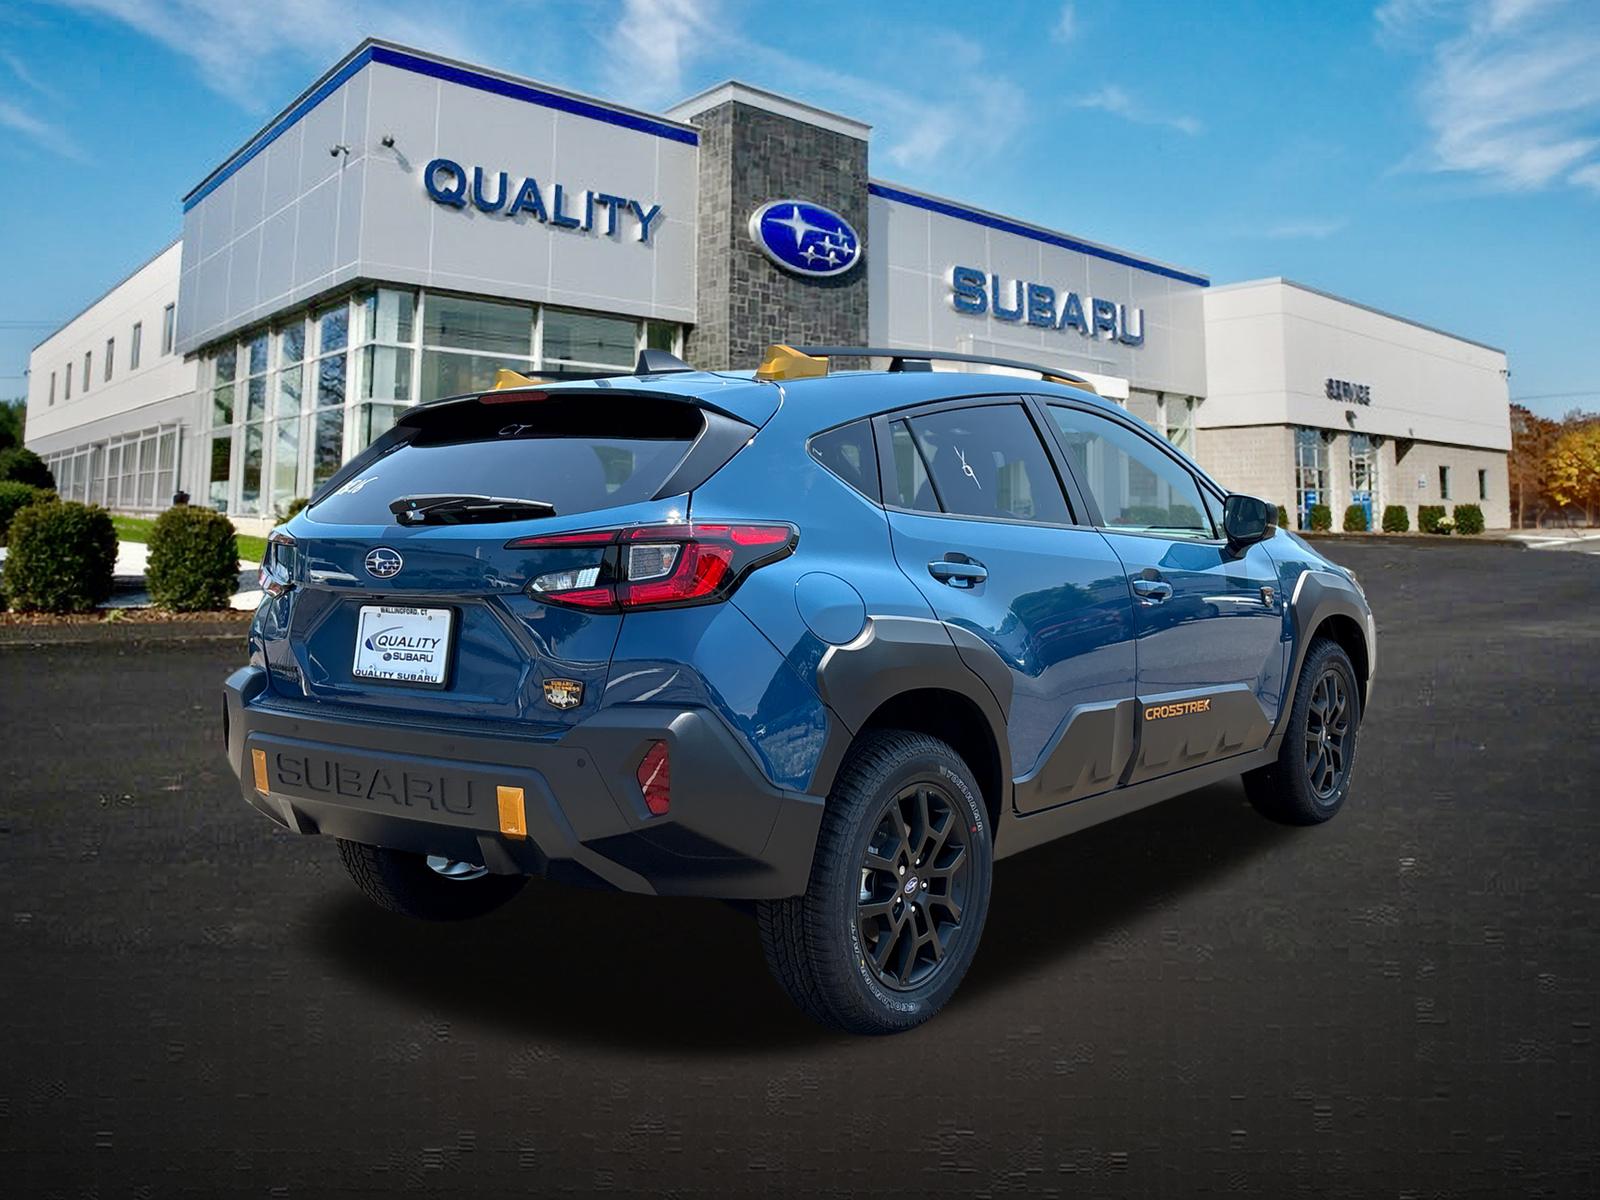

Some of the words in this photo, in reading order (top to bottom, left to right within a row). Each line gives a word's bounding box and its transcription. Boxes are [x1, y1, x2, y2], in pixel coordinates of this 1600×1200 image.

[424, 157, 662, 243] QUALITY
[951, 265, 1145, 346] SUBARU
[1325, 378, 1371, 406] SERVICE
[377, 634, 441, 649] QUALITY
[392, 651, 434, 663] SUBARU
[354, 668, 395, 679] QUALITY
[396, 671, 438, 683] SUBARU
[1144, 698, 1211, 721] CROSSTREK
[276, 752, 476, 816] SUBARU
[945, 768, 984, 832] YOKOHAMA
